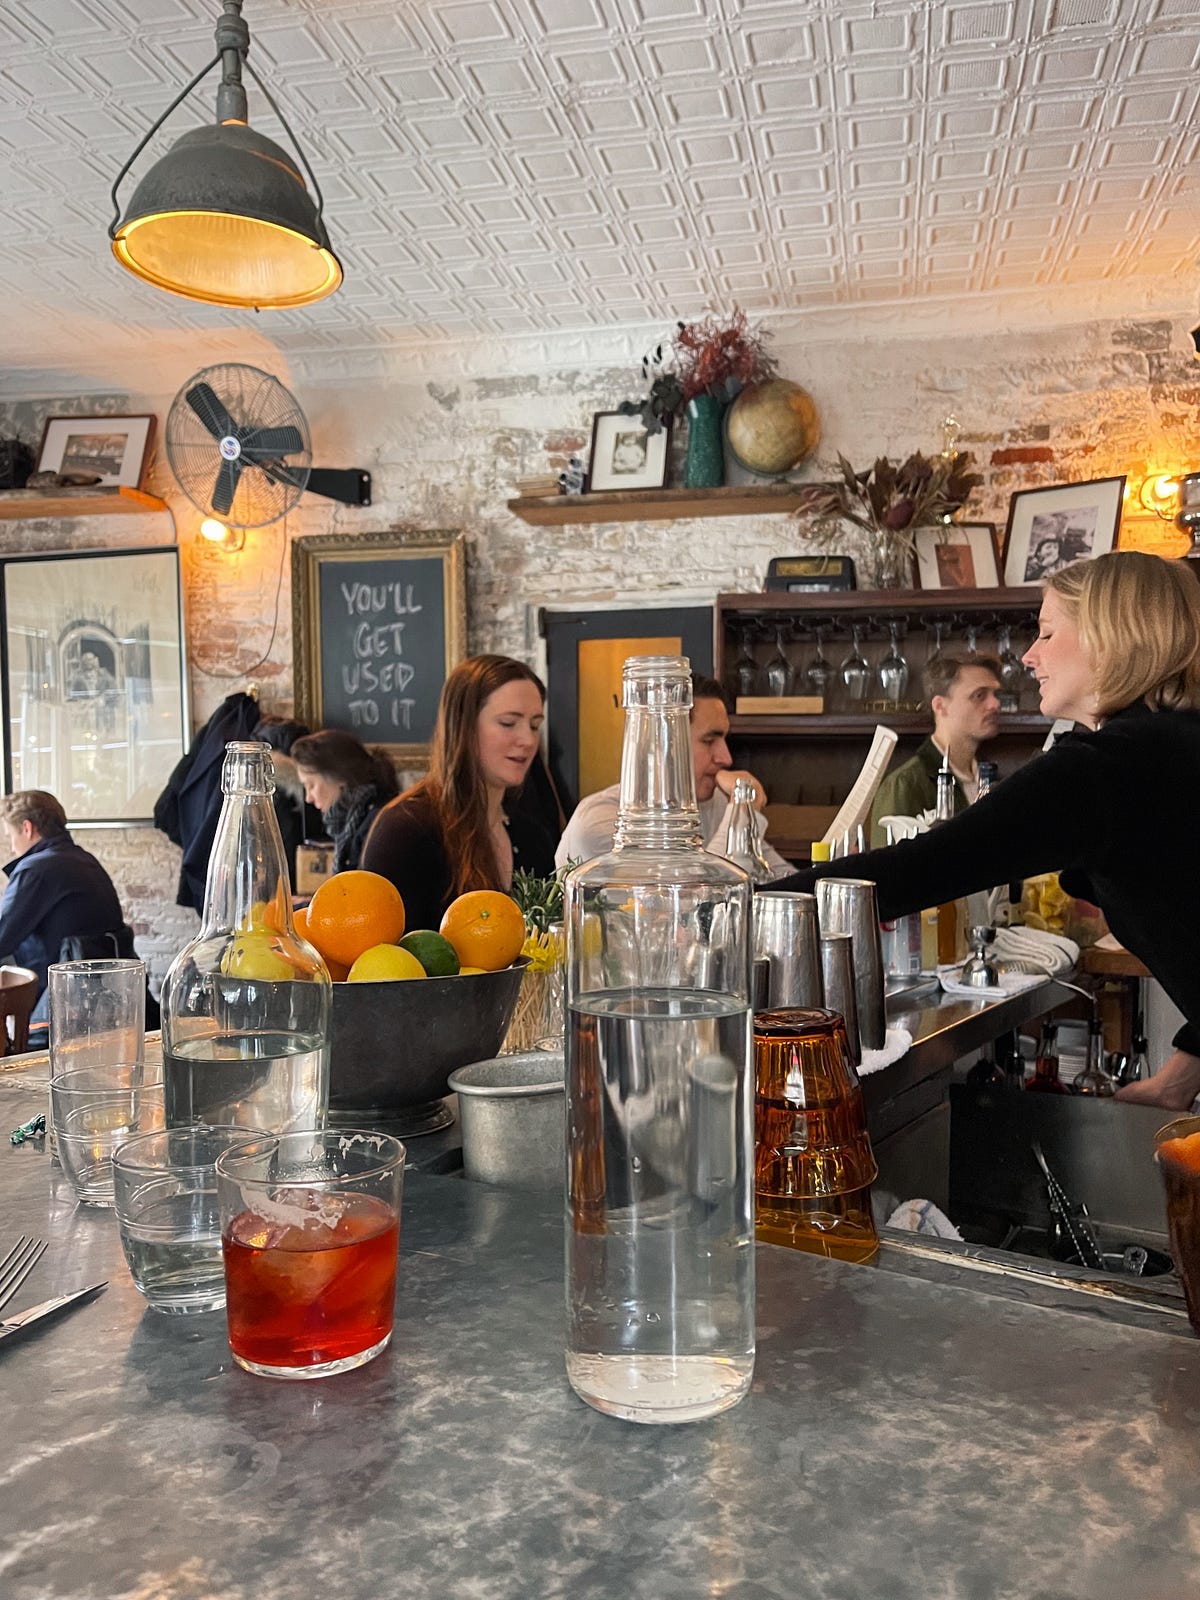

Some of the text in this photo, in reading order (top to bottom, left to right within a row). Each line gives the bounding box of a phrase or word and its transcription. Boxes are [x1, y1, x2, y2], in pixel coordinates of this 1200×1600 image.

[341, 581, 422, 616] YOU'LL
[354, 621, 405, 659] GET
[341, 661, 415, 695] USED
[348, 698, 416, 730] TO IT
